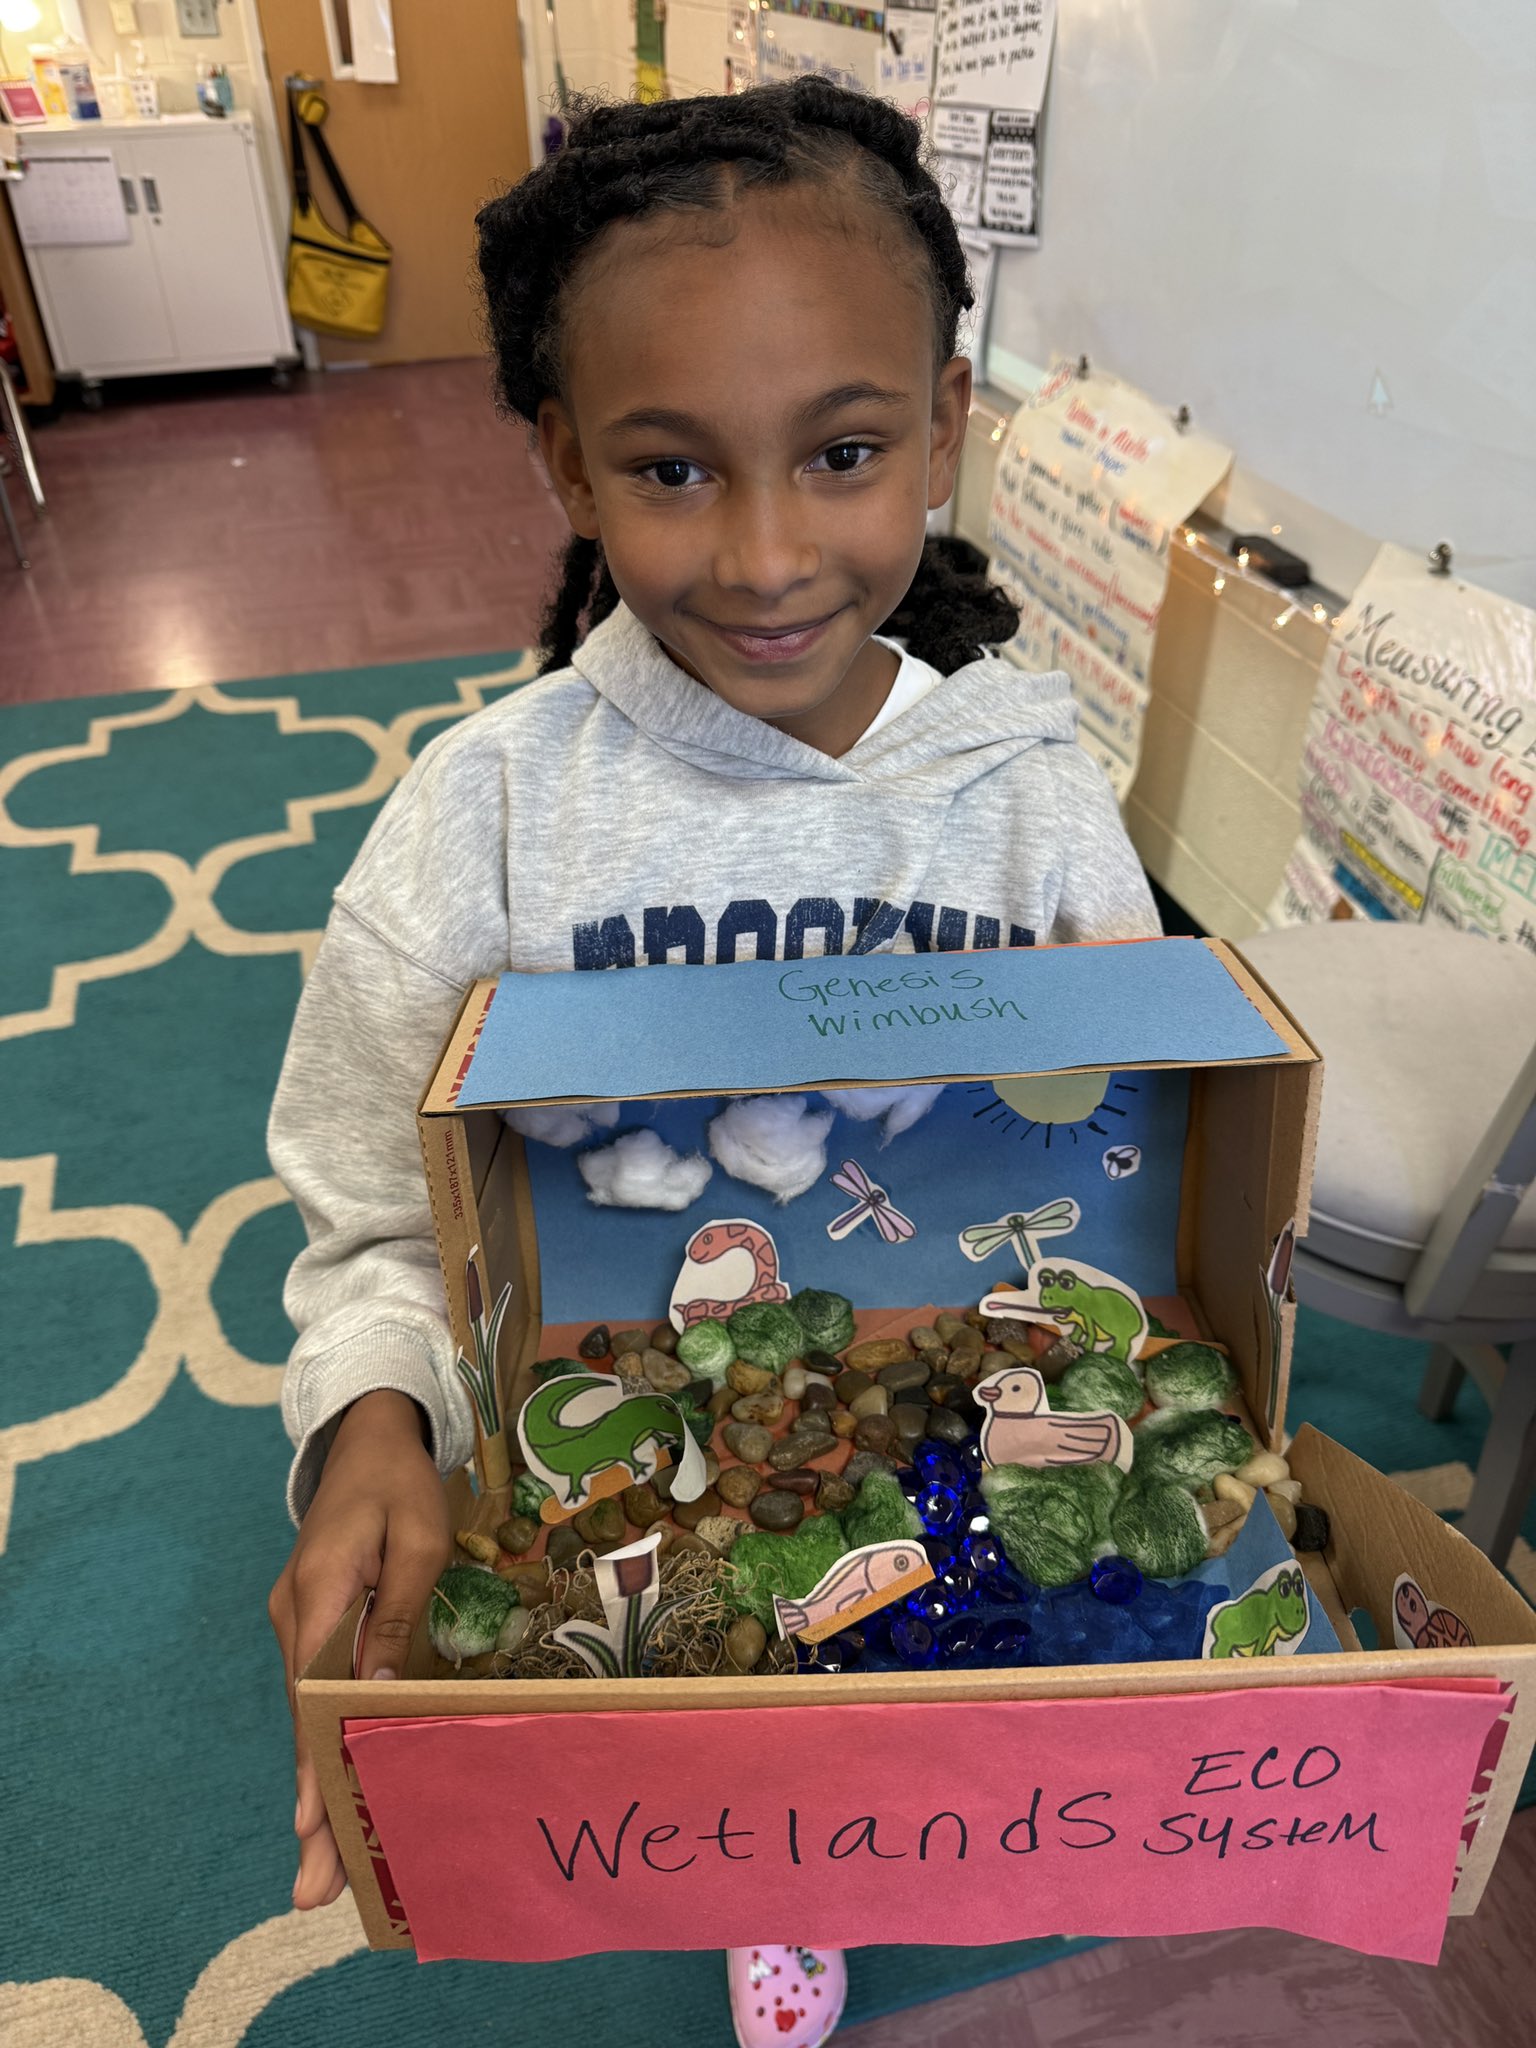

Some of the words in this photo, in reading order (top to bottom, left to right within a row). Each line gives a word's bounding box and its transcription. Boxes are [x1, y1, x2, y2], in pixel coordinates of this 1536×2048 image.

[1344, 603, 1523, 750] Measuring
[1408, 711, 1430, 739] is
[1441, 719, 1483, 768] how
[1490, 755, 1533, 816] long
[1435, 768, 1531, 856] something
[778, 969, 984, 1006] Genesis
[444, 1129, 464, 1221] 335x187x121mm
[1184, 1745, 1341, 1795] ECO
